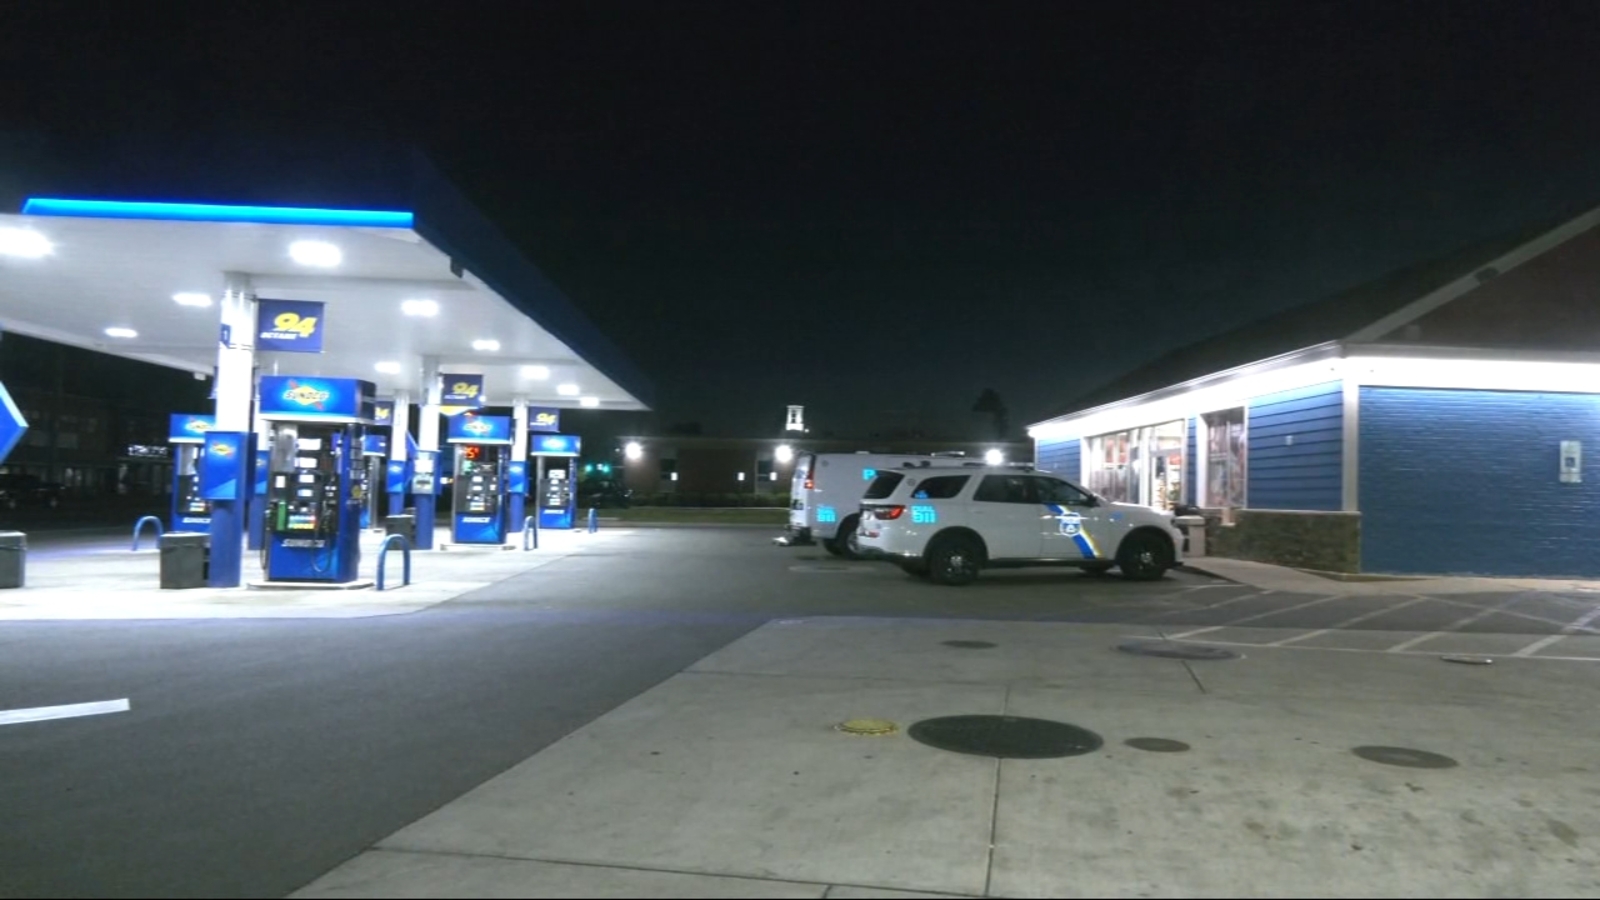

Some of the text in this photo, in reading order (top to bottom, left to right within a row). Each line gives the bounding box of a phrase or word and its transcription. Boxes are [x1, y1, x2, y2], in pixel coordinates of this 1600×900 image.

[273, 312, 317, 338] 94
[260, 331, 298, 340] OCTANE
[453, 382, 479, 398] 94
[536, 412, 558, 425] 94
[863, 468, 876, 480] P
[912, 511, 936, 524] 911
